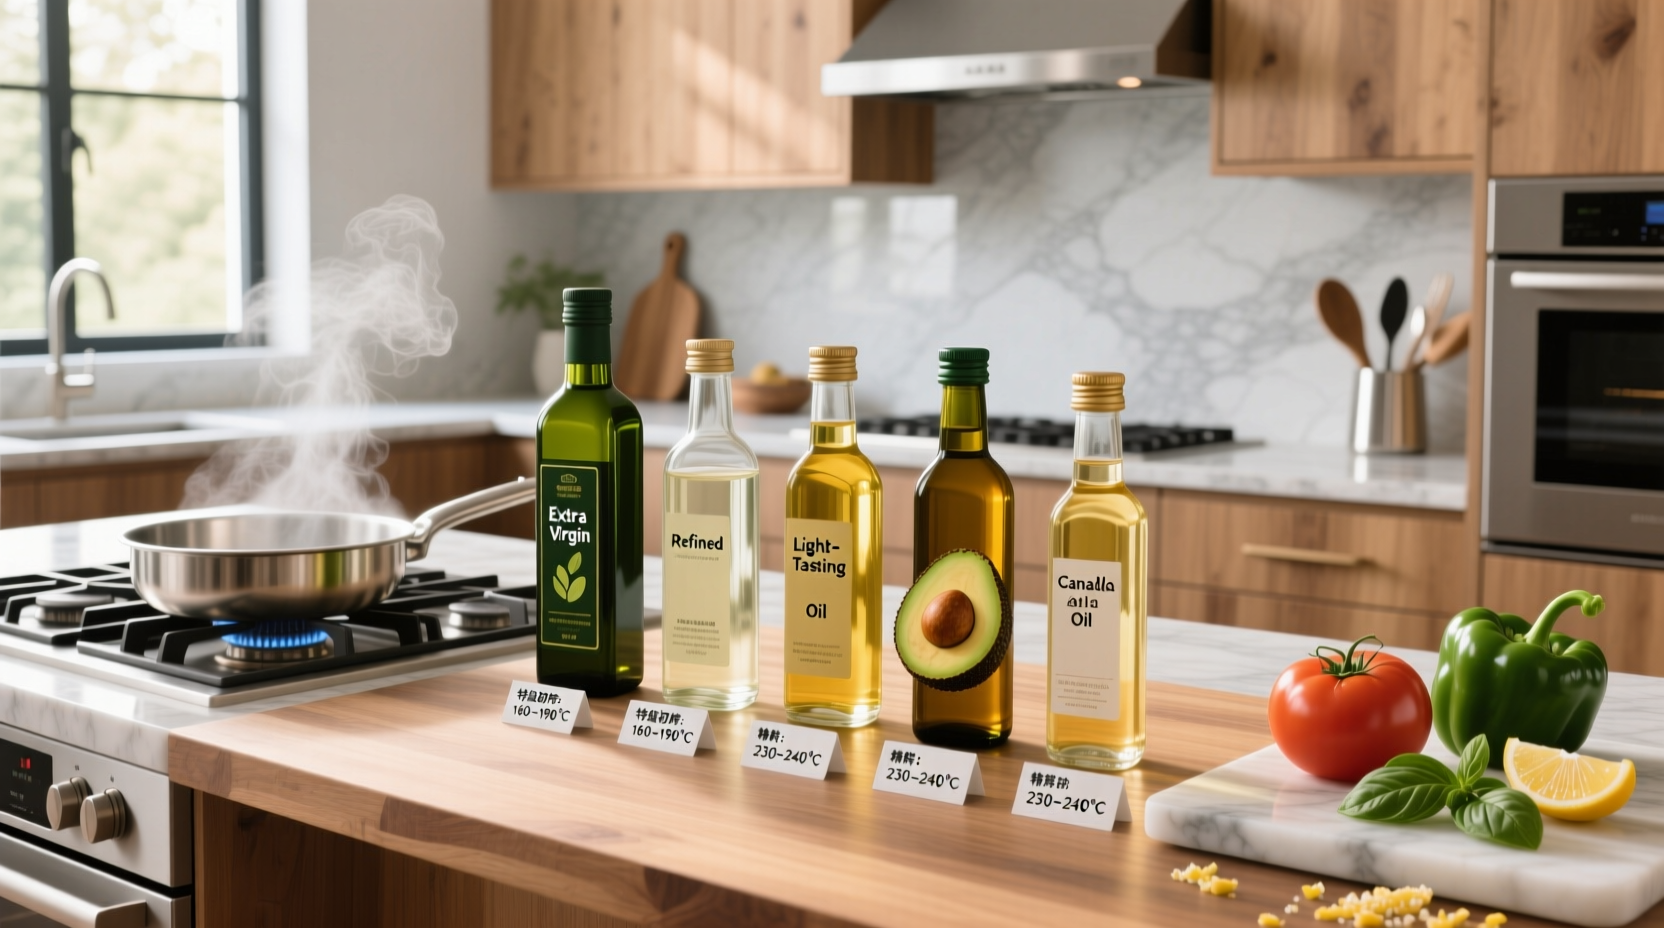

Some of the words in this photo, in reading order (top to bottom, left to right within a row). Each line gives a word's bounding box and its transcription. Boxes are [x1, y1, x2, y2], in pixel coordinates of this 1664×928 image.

[548, 505, 587, 524] Extra
[549, 525, 591, 547] Virgin
[671, 533, 724, 550] Refined
[793, 536, 841, 557] Light-
[793, 556, 847, 578] Tasting
[805, 603, 827, 619] Oil
[1070, 611, 1093, 627] Oil
